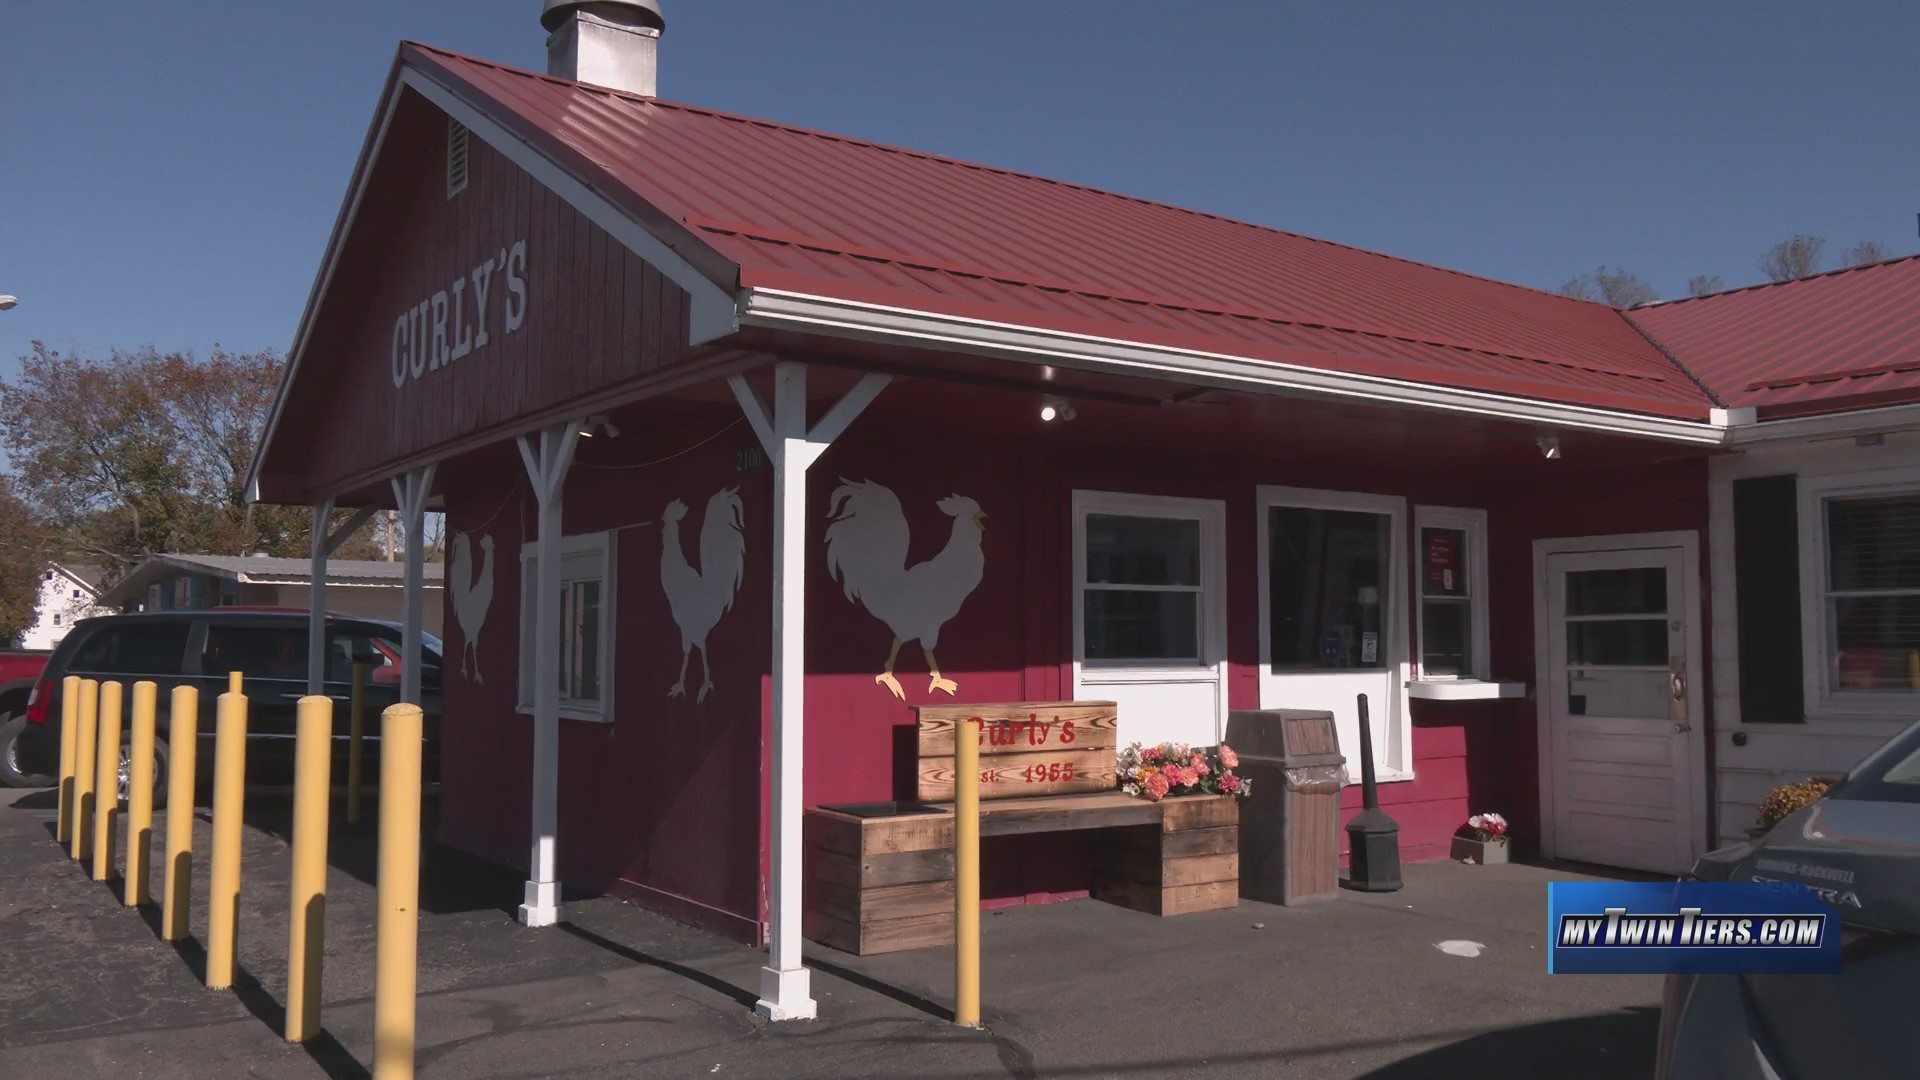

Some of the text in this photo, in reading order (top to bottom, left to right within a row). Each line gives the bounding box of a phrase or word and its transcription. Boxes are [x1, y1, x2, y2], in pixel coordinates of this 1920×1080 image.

[392, 239, 528, 389] CURLY'S
[980, 762, 1074, 784] st. 1955
